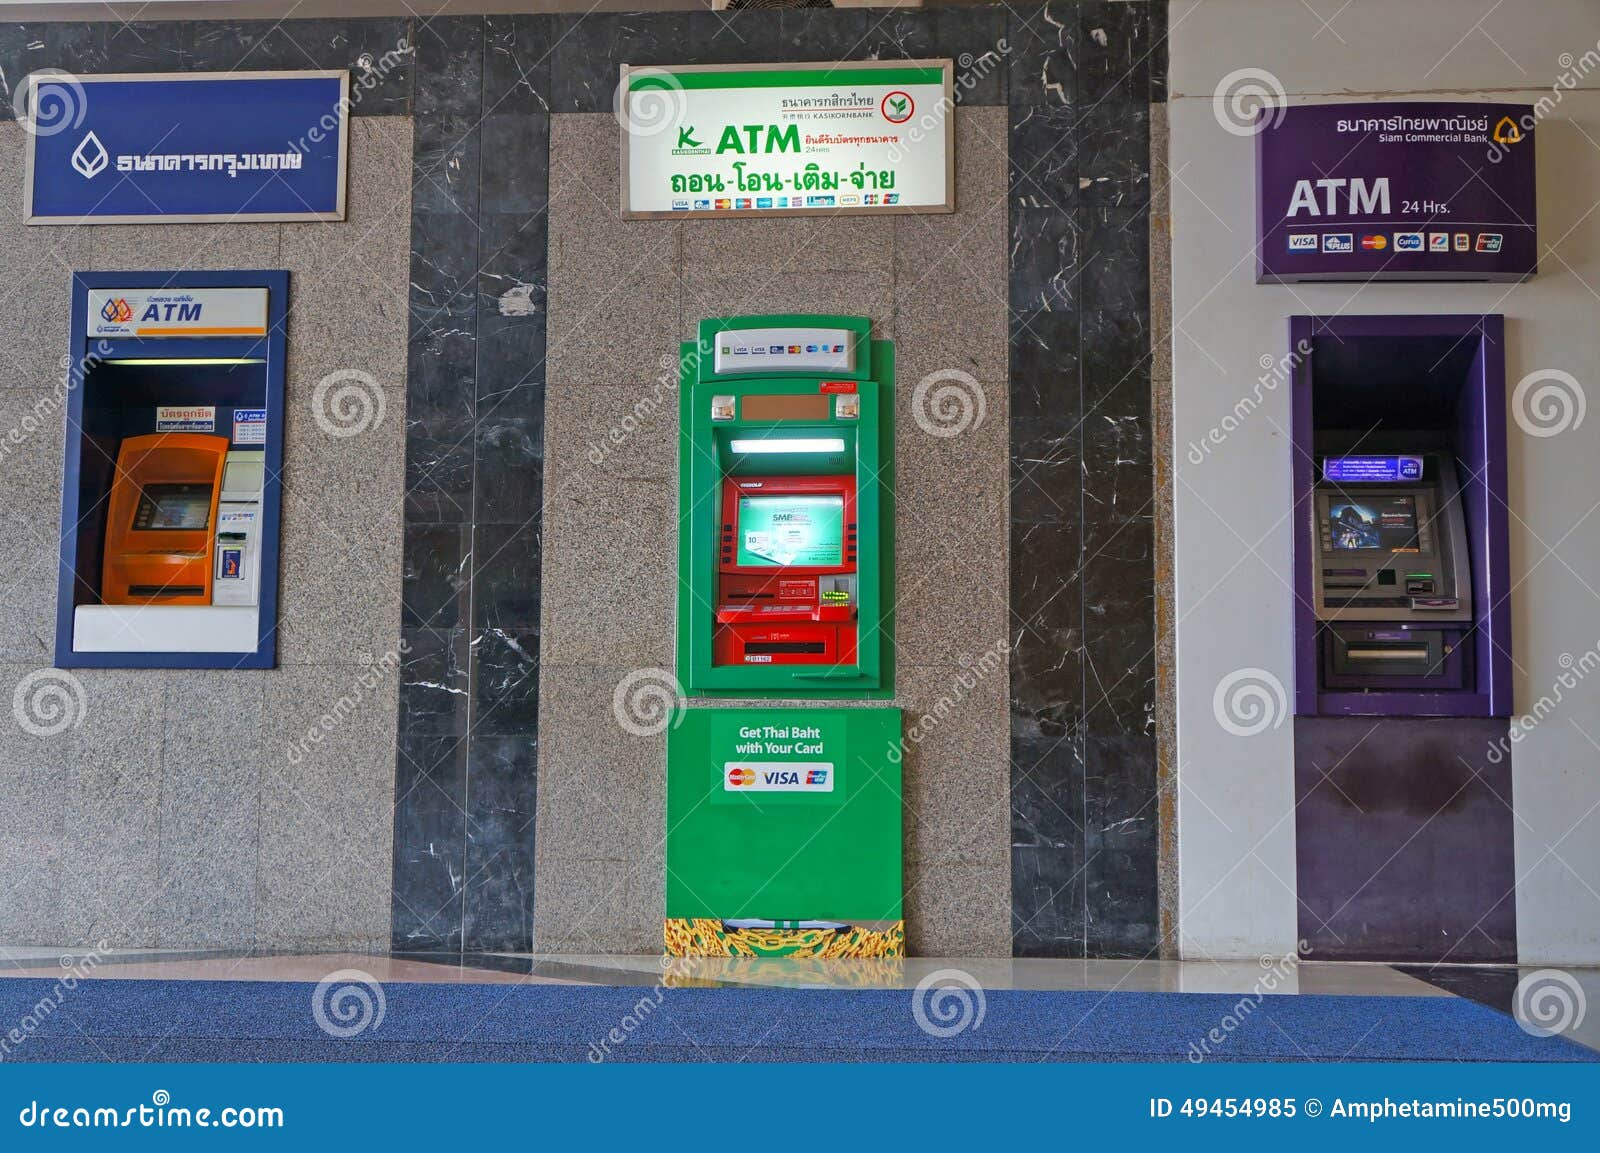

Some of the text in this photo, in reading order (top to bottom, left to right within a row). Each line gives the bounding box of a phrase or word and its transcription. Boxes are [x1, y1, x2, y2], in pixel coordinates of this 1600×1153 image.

[782, 92, 874, 108] ธนาคารกสิกรไทย
[1337, 115, 1488, 133] ธนาคารไทยพาณิชย์
[715, 124, 801, 154] ATM
[1379, 133, 1488, 143] Siam Commercial Bank
[117, 153, 302, 178] ธนาคารกรุงเทพ
[1286, 178, 1450, 217] ATM 24 Hrs.
[1291, 237, 1316, 247] VISA
[1332, 241, 1351, 250] PLUS
[141, 304, 202, 322] ATM
[739, 726, 820, 739] Get Thai Baht
[736, 742, 824, 754] with Your Card
[763, 772, 799, 784] VISA
